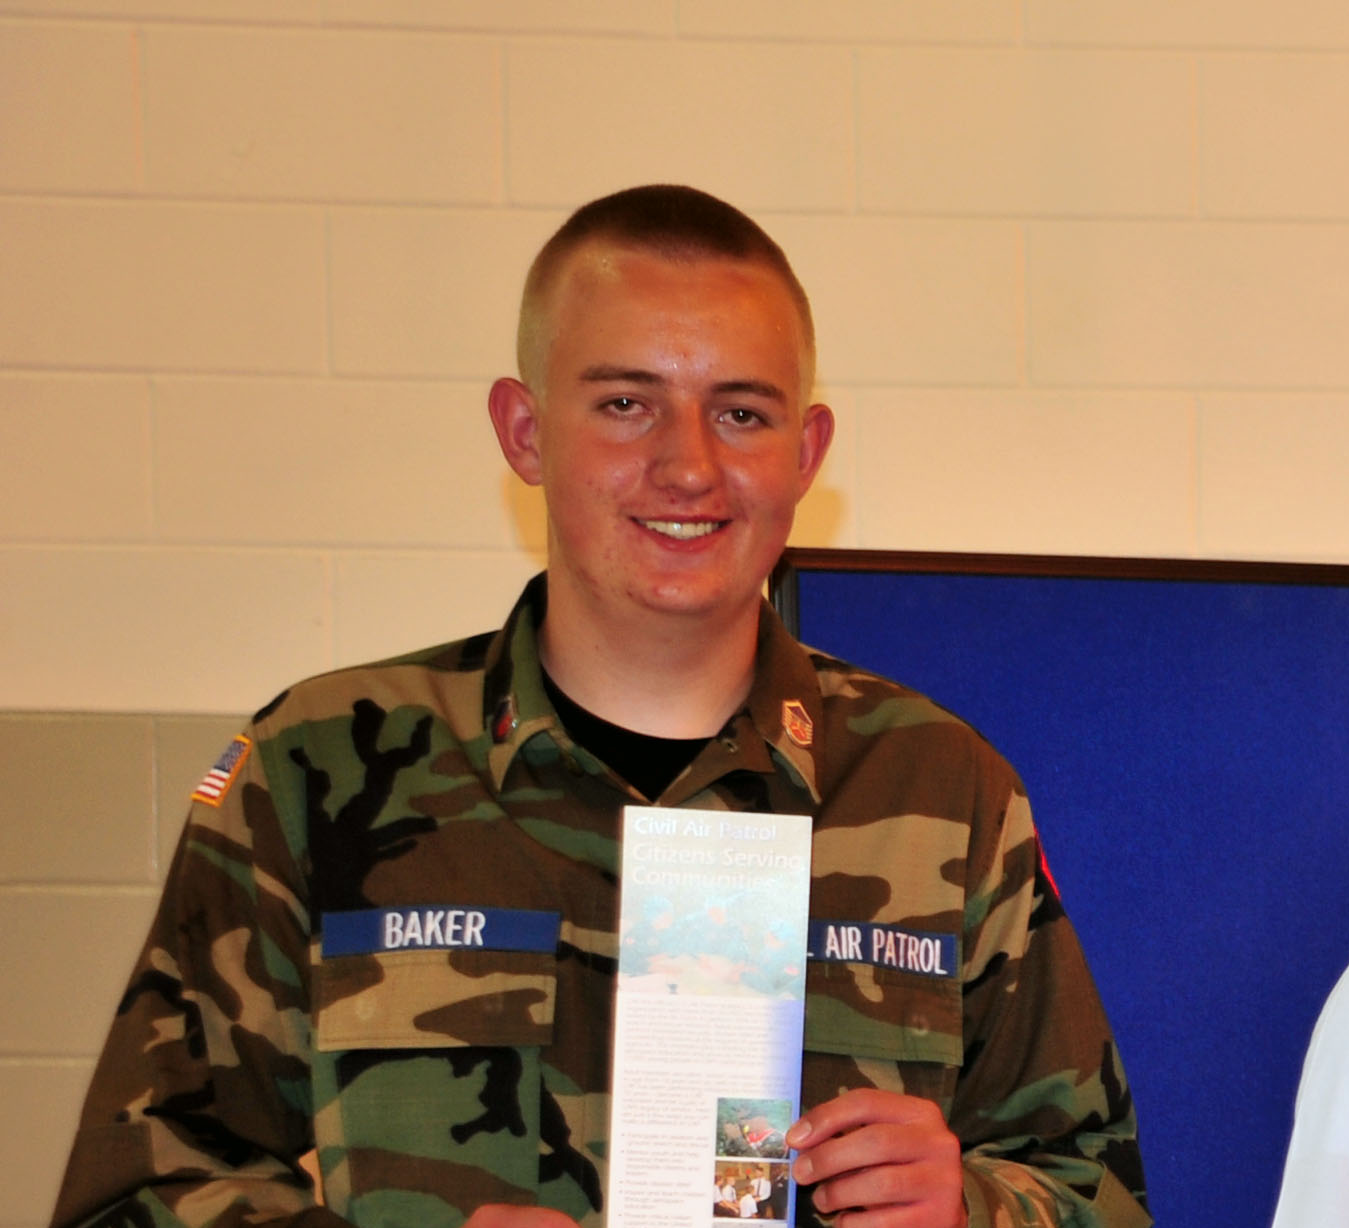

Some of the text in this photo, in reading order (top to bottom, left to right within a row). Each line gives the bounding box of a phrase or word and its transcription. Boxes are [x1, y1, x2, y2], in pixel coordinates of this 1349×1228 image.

[634, 816, 677, 835] Civil
[683, 819, 712, 837] Air
[385, 910, 486, 948] BAKER
[825, 925, 948, 975] AIR PATROL
